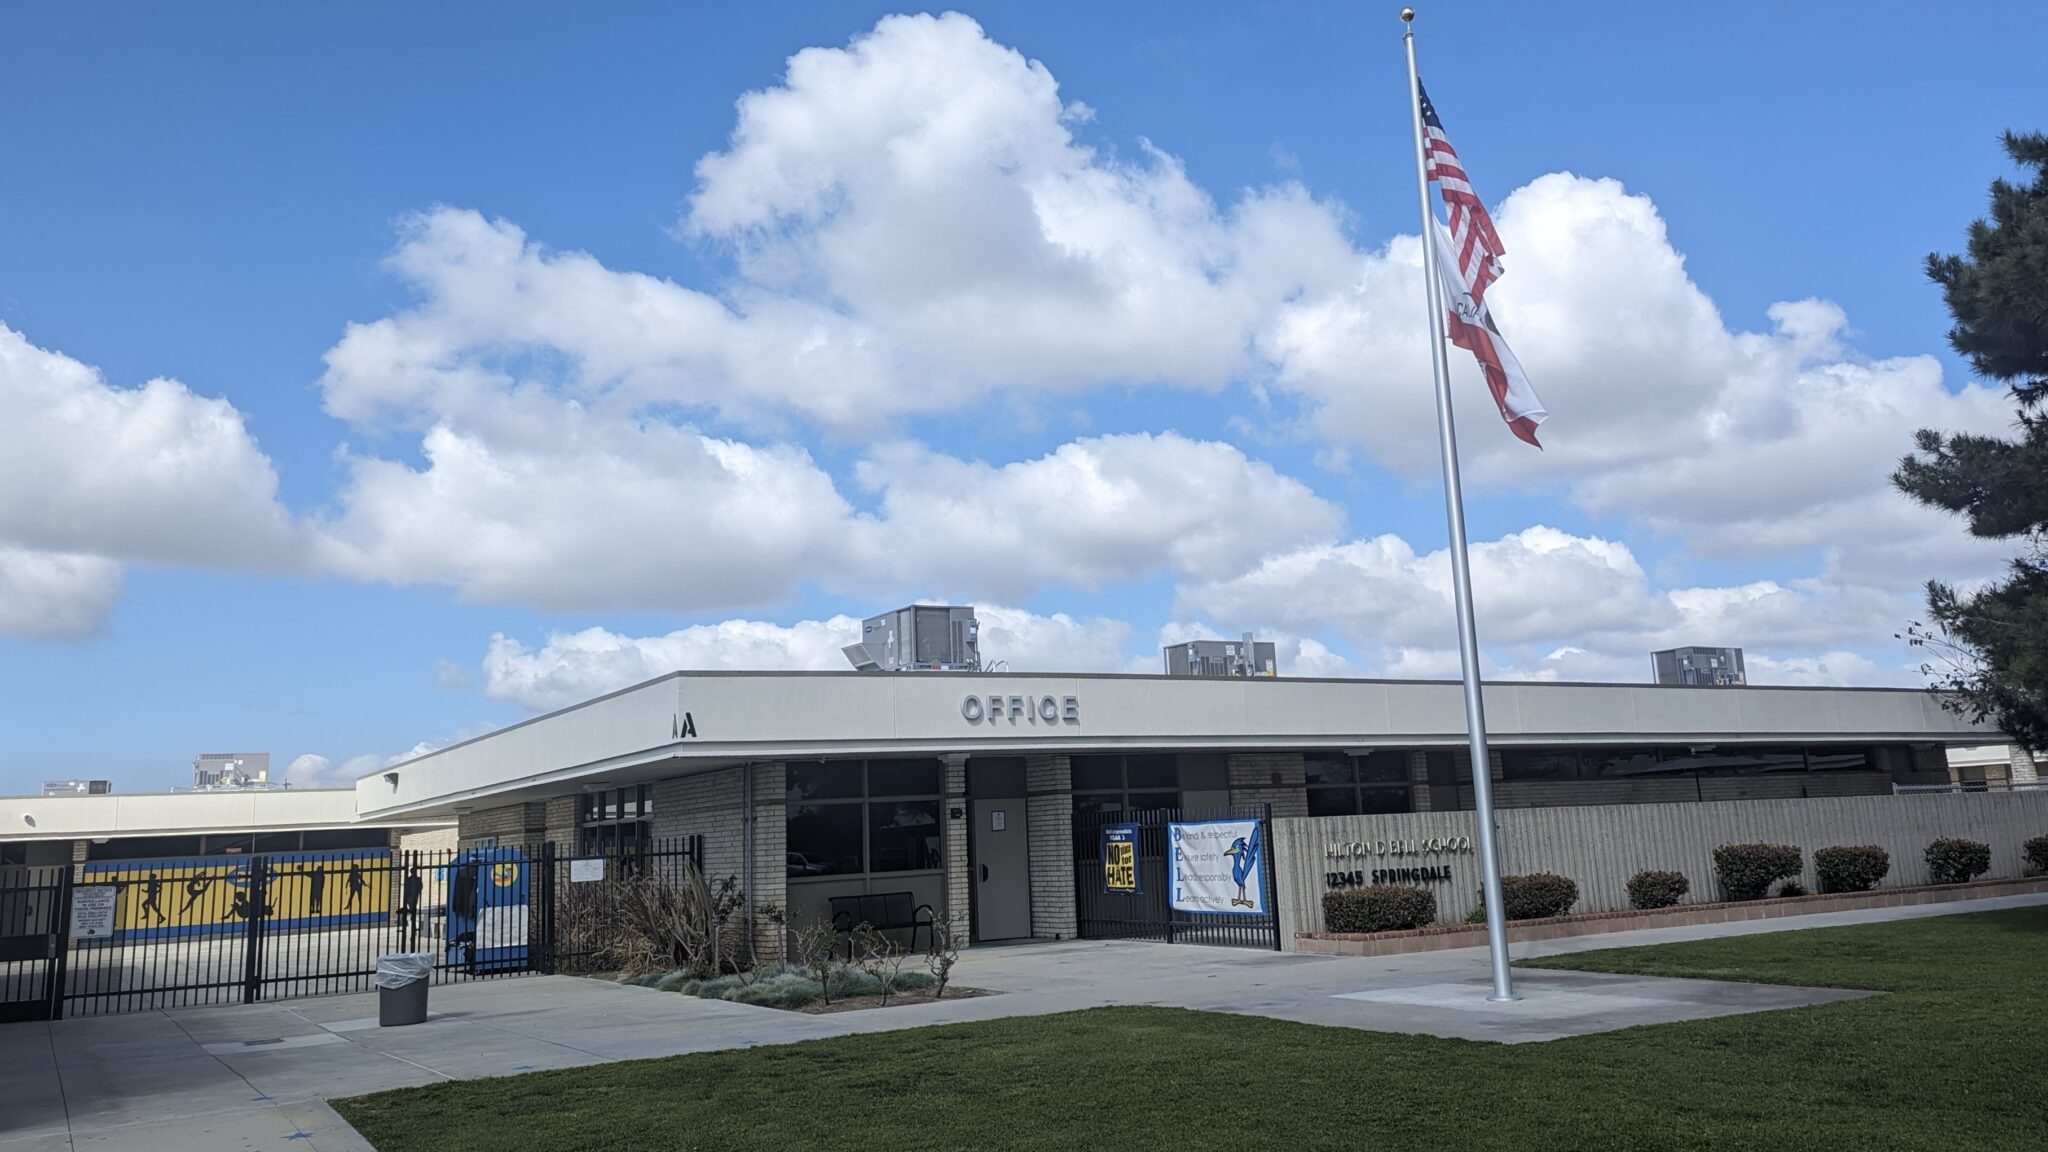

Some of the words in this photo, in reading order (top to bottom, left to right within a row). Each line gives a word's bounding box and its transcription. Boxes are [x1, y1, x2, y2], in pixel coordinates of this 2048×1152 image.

[961, 695, 1077, 720] OFFICE
[681, 712, 697, 738] A
[1207, 829, 1237, 840] respectful
[1108, 844, 1120, 865] NO
[1324, 841, 1370, 857] HILTON
[1376, 841, 1385, 855] D
[1389, 839, 1417, 855] BELL
[1422, 836, 1473, 854] SCHOOL
[1107, 866, 1133, 885] HATE
[1326, 870, 1363, 888] 12345
[1372, 865, 1452, 885] SPRINGDALE
